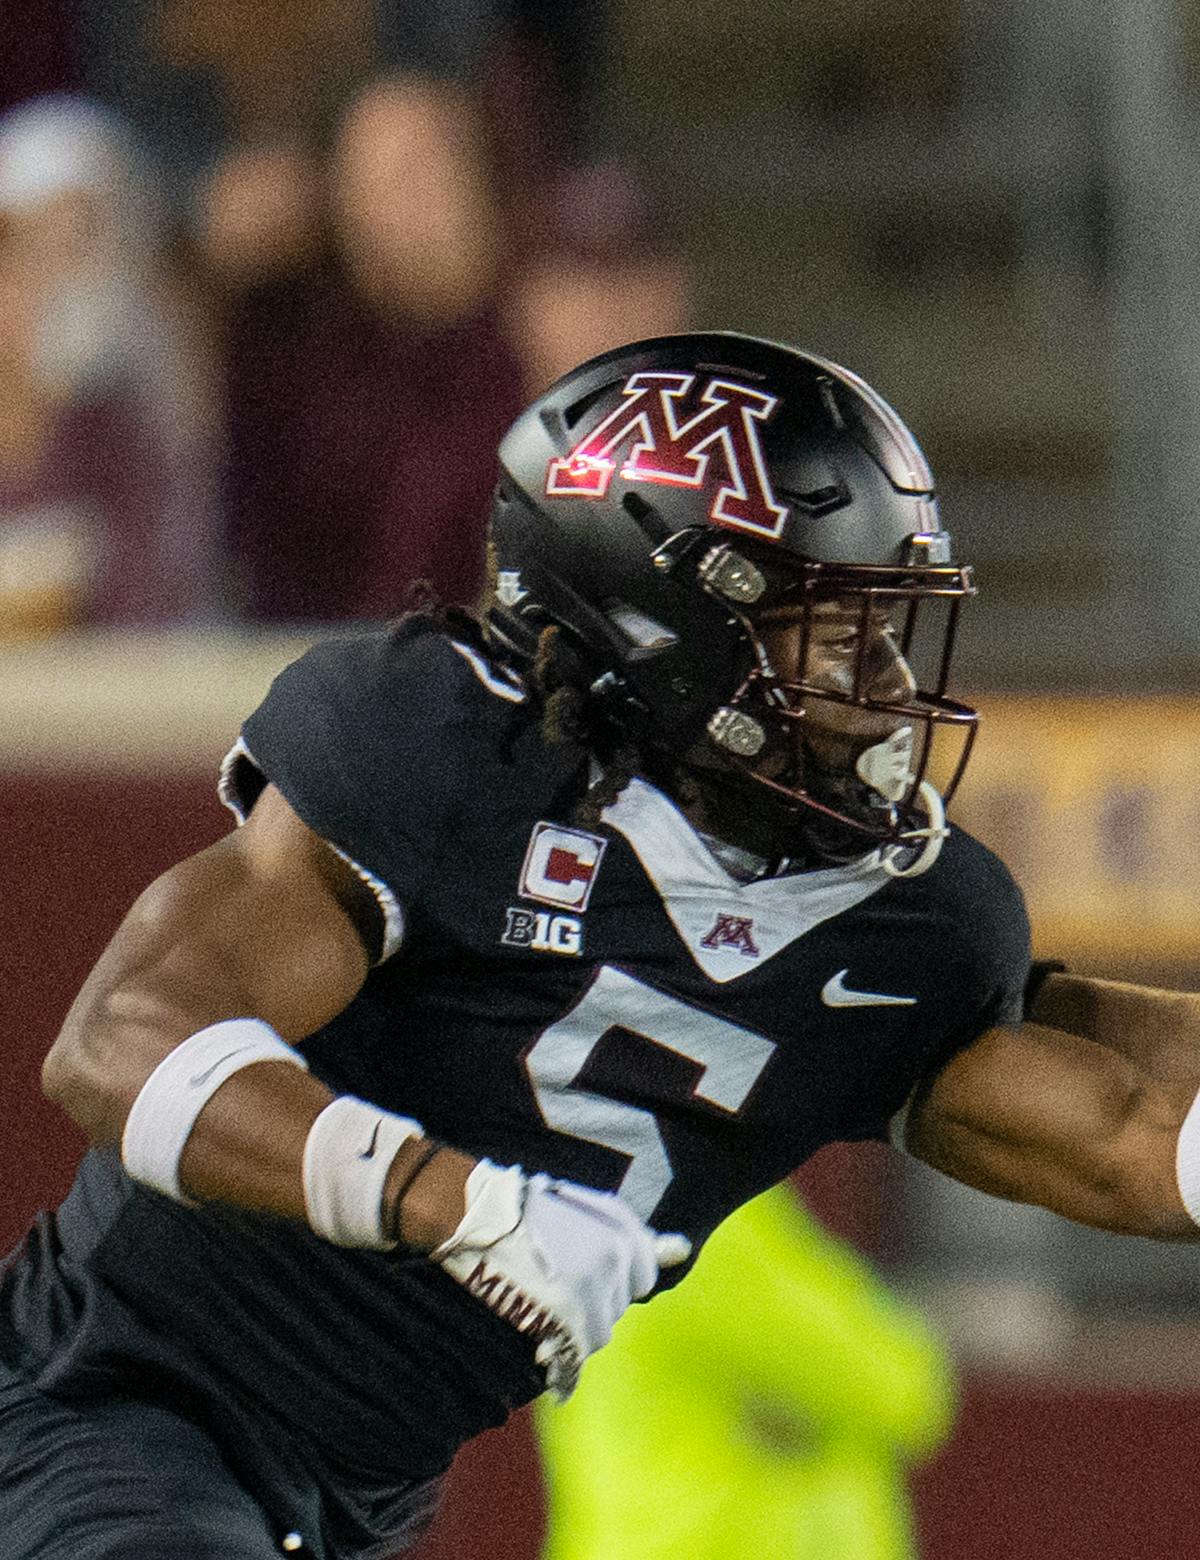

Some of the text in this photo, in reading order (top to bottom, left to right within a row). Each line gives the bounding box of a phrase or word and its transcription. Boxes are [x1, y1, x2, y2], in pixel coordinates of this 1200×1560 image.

[545, 370, 789, 539] M
[522, 826, 602, 906] C
[701, 912, 759, 957] M
[519, 963, 778, 1224] 5
